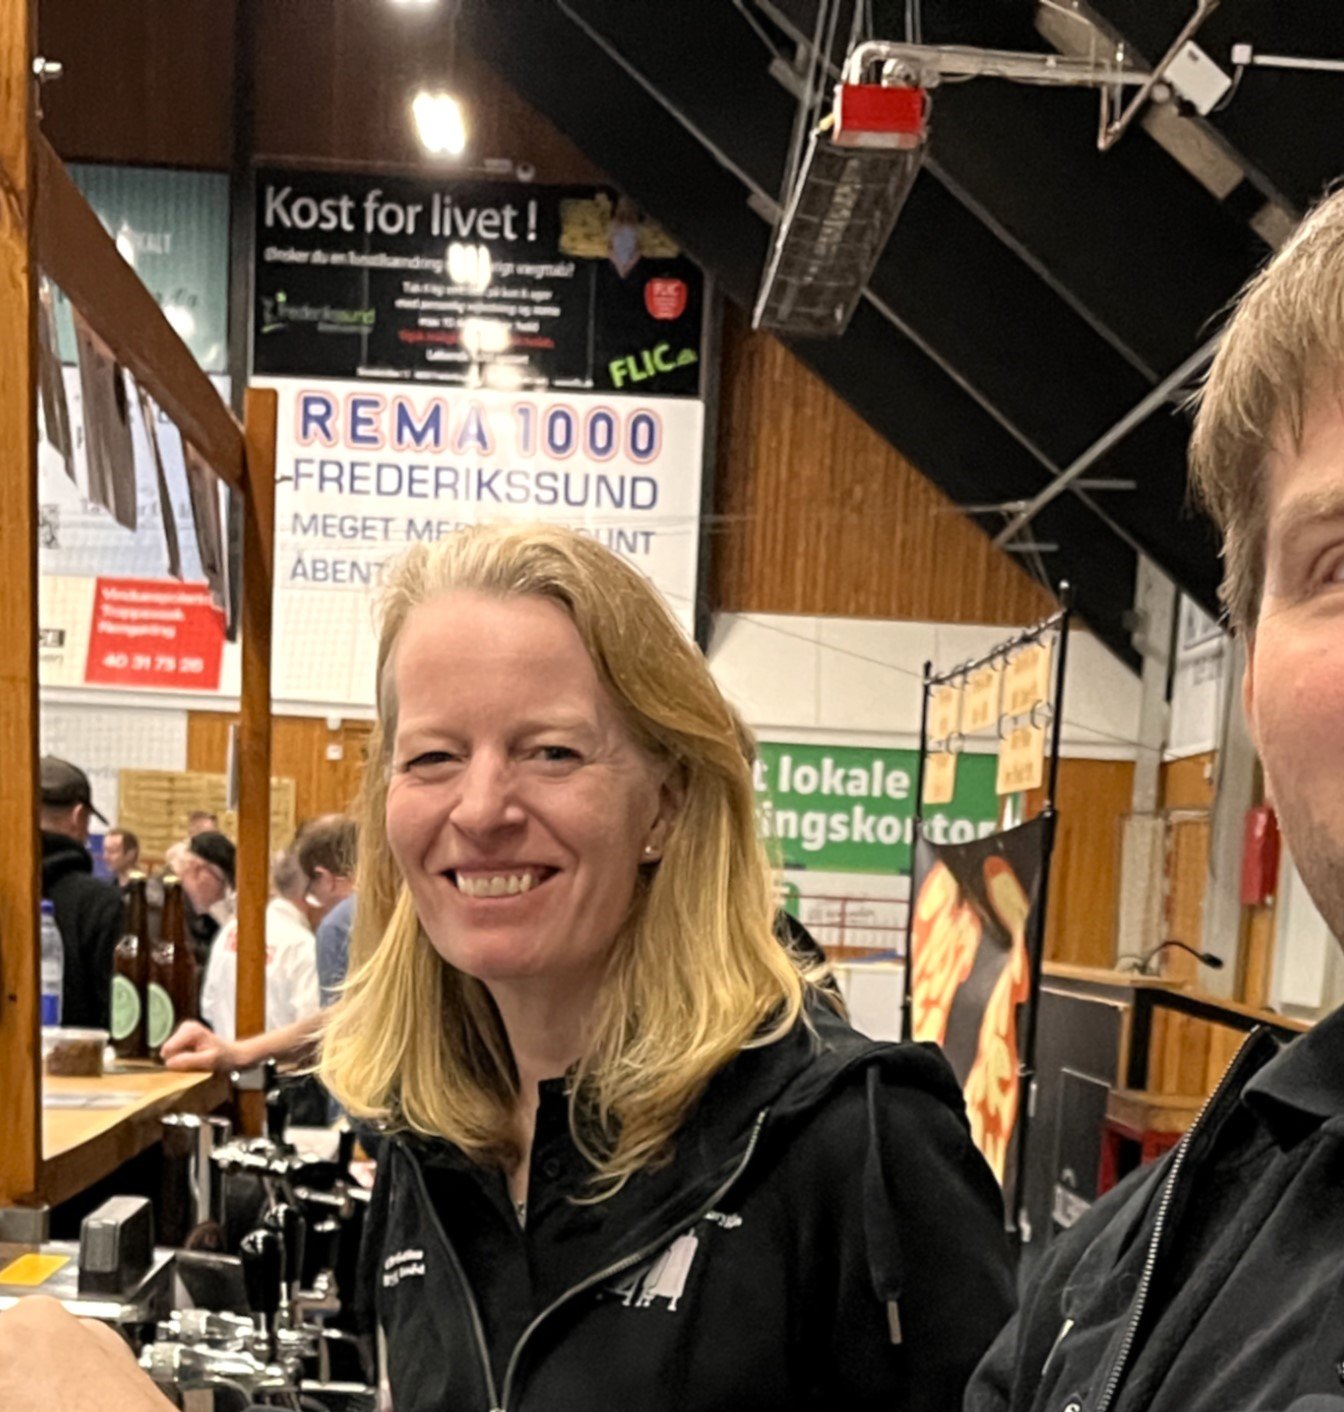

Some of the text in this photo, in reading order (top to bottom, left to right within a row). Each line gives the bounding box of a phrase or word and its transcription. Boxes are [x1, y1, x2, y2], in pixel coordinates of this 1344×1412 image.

[264, 185, 355, 232] Kost
[364, 188, 423, 235] for
[431, 192, 518, 241] livet
[296, 390, 663, 465] REMA 1000
[293, 459, 658, 511] FREDERIKSSUND
[291, 512, 395, 542] MEGET
[778, 754, 911, 799] lokale
